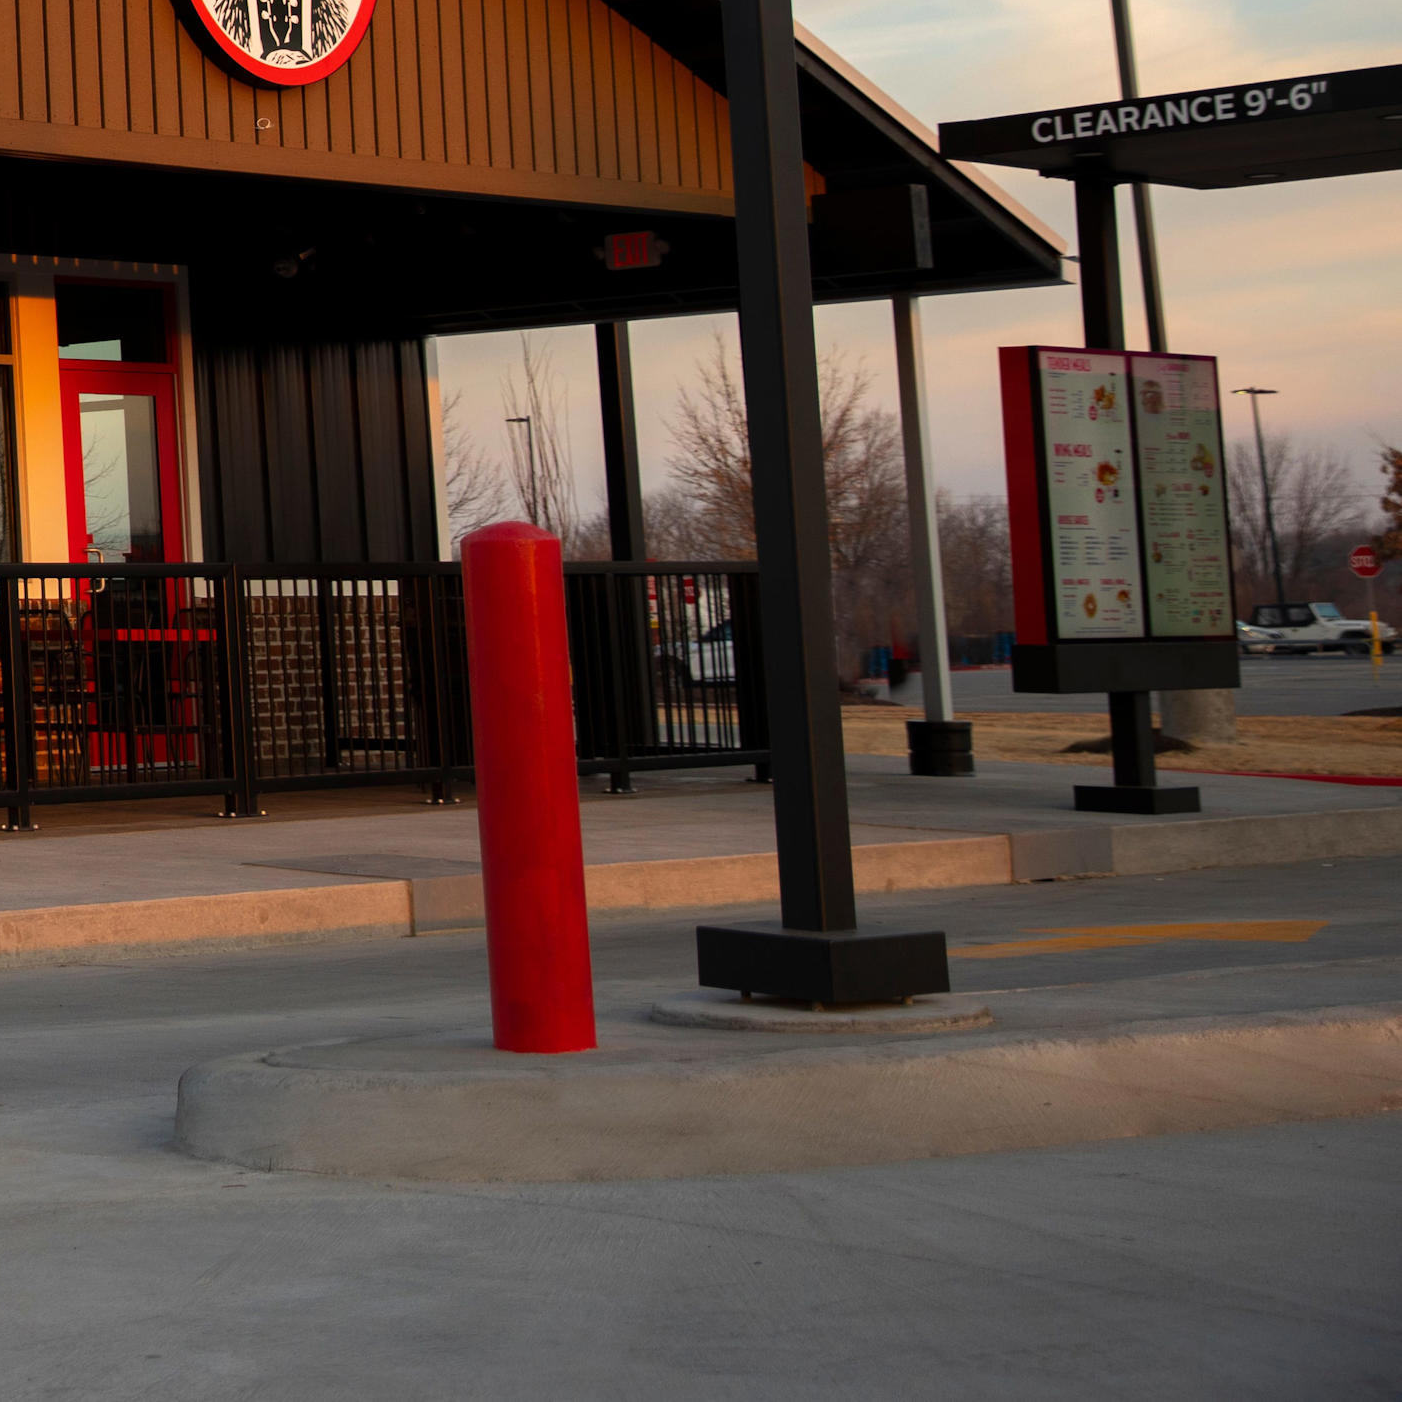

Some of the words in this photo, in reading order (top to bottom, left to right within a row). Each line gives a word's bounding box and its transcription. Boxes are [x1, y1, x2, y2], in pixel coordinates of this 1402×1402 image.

[1031, 93, 1236, 144] CLEARANCE
[612, 232, 649, 267] EXIT
[1350, 555, 1376, 568] STO
